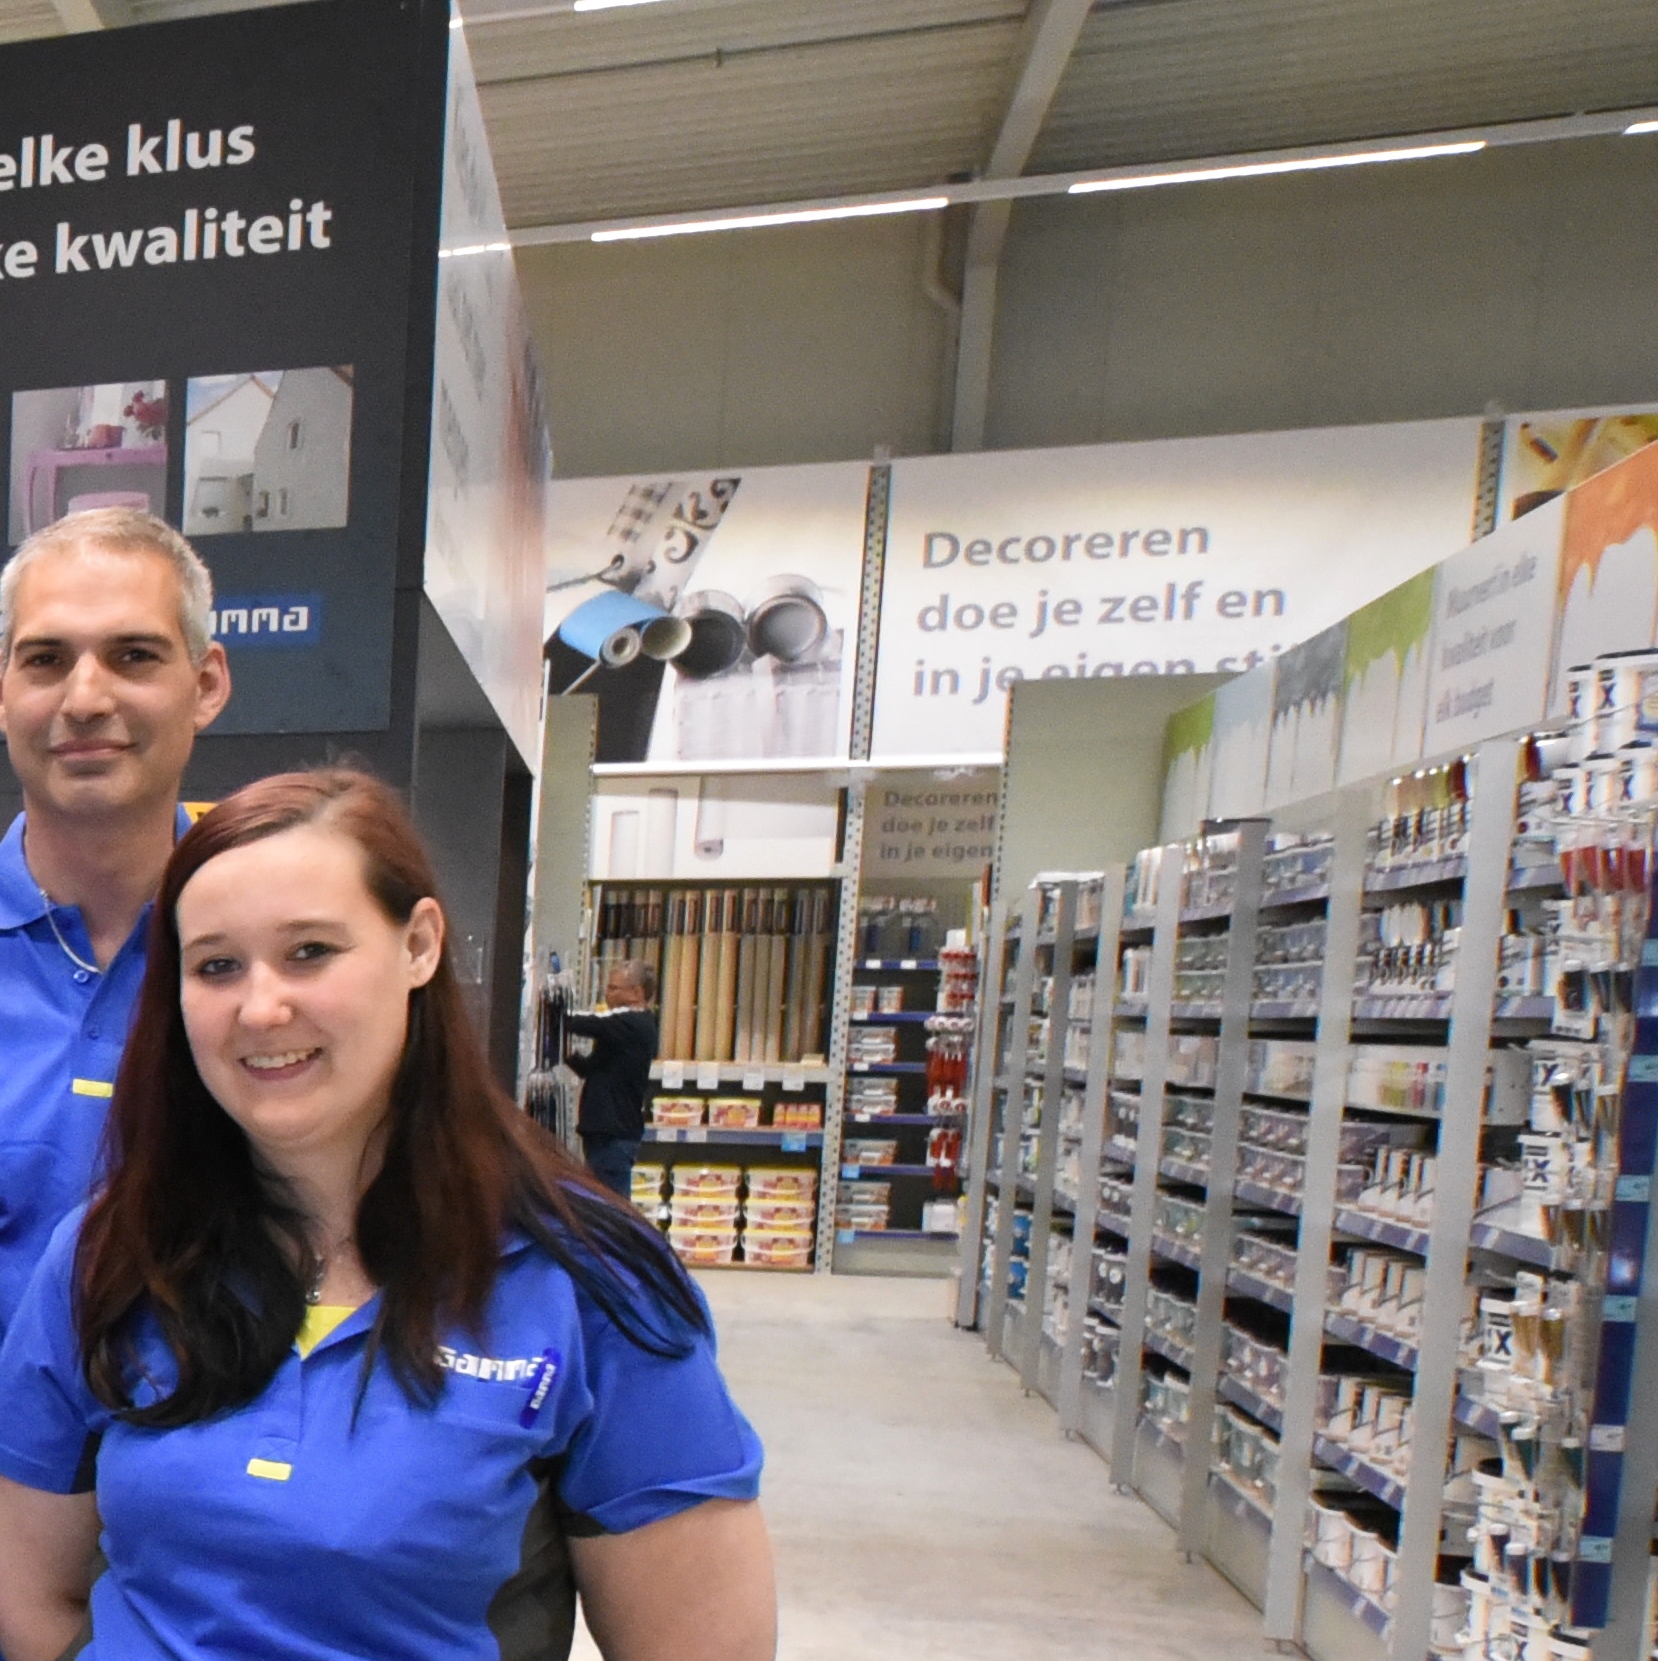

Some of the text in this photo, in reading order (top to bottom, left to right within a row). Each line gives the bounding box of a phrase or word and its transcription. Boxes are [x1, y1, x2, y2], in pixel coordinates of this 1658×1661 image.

[126, 118, 256, 177] klus
[54, 197, 333, 275] kwaliteit
[922, 526, 1210, 569] Decoreren
[917, 581, 1285, 638] doe je zelf en
[913, 659, 960, 696] in
[973, 656, 1024, 704] je
